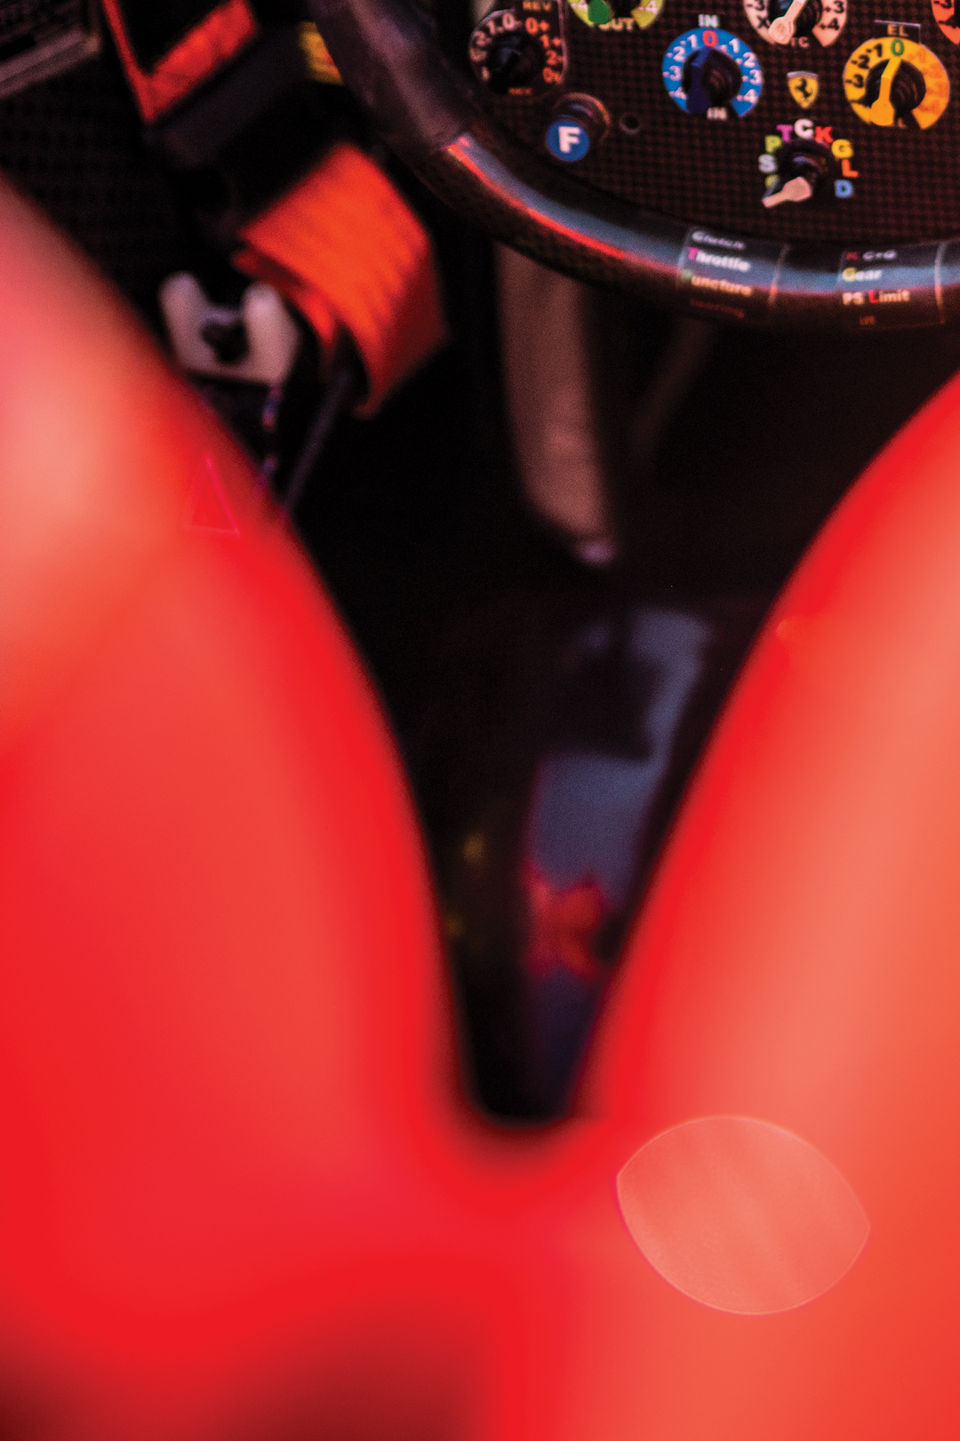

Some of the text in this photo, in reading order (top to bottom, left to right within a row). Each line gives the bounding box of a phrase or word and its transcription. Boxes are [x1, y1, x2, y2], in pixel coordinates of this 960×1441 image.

[698, 14, 719, 29] IN
[886, 23, 909, 37] EL
[702, 29, 719, 48] 0
[890, 39, 905, 57] 0
[776, 124, 794, 143] T
[794, 118, 815, 140] C
[815, 125, 834, 144] K
[558, 125, 581, 153] F
[831, 138, 854, 159] G
[841, 158, 860, 178] L
[867, 285, 912, 304] Limit
